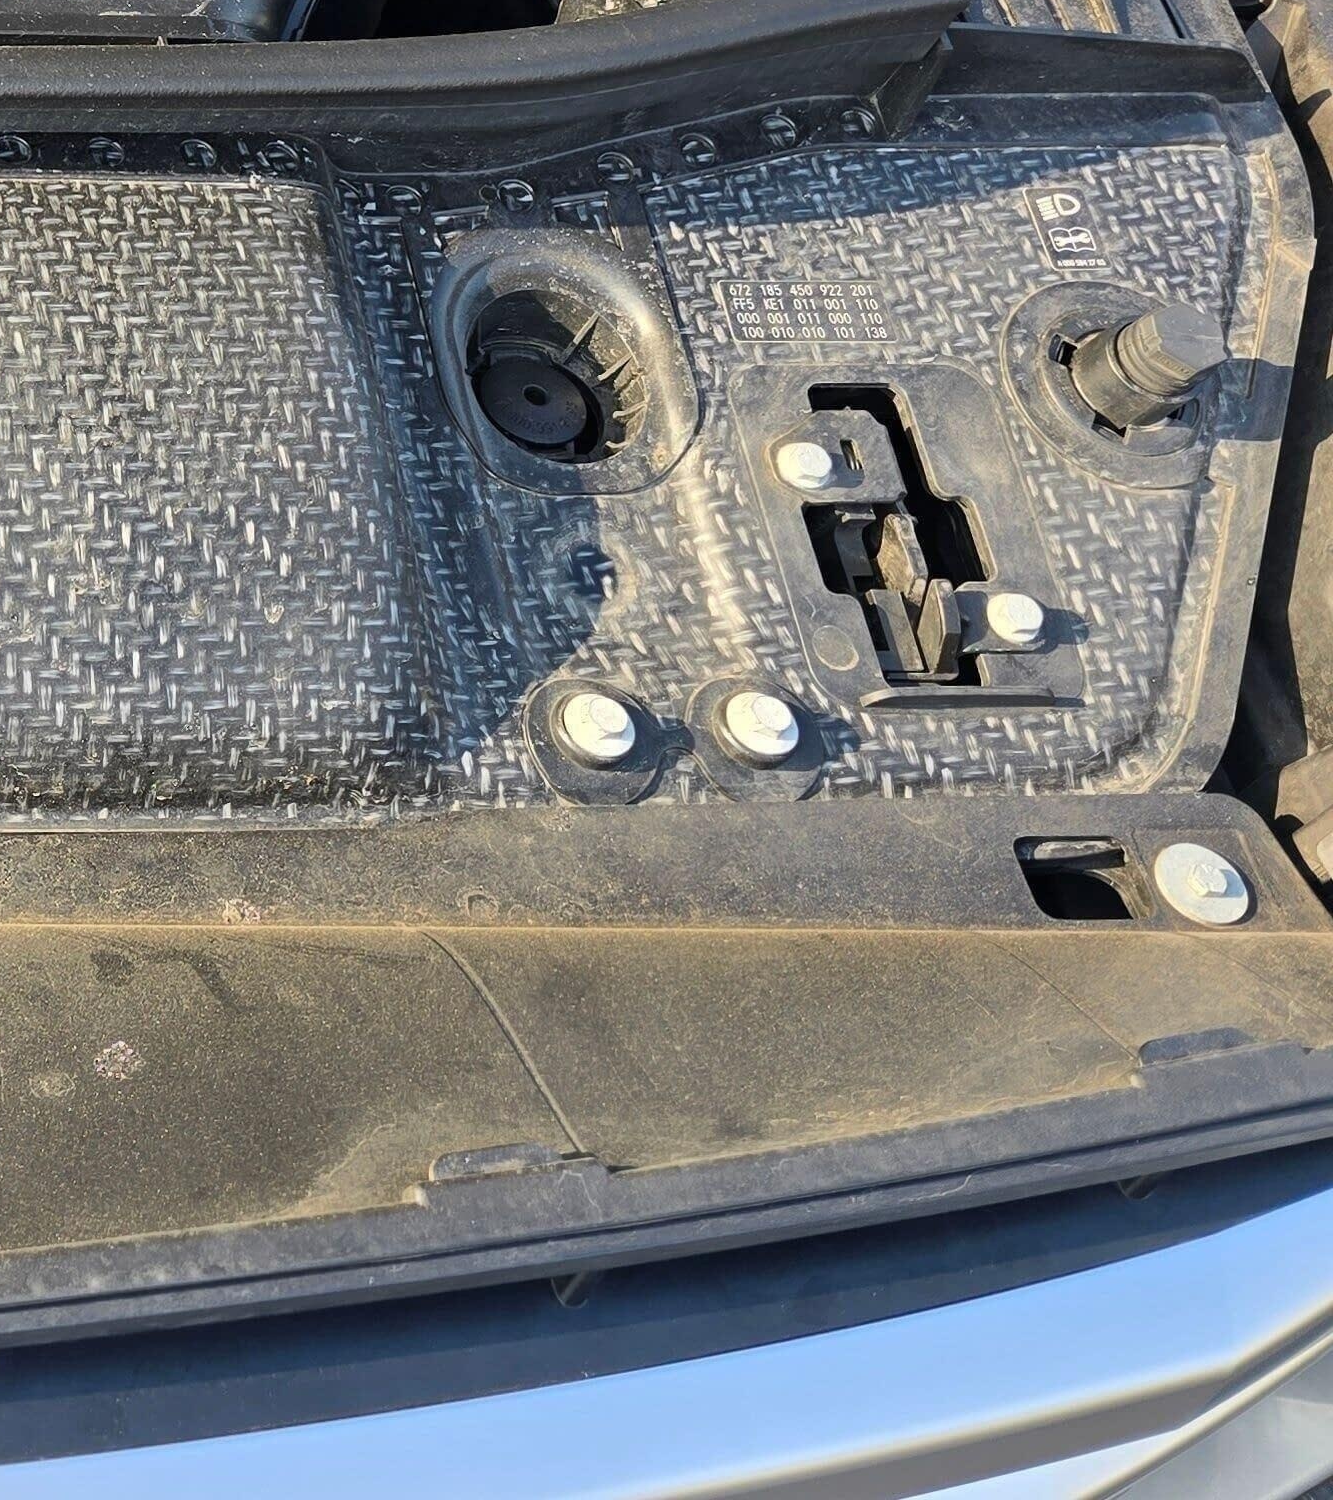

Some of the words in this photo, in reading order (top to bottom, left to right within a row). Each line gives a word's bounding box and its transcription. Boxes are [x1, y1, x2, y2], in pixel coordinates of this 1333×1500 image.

[729, 284, 752, 297] 672
[760, 284, 783, 297] 185
[789, 284, 813, 297] 450
[819, 284, 844, 297] 922
[849, 284, 873, 297] 201
[733, 298, 755, 311] FF5
[764, 298, 785, 311] KE1
[793, 298, 816, 311] 011
[824, 298, 847, 311] 001
[856, 298, 879, 311] 110
[736, 312, 760, 325] 000
[767, 312, 790, 325] 001
[797, 312, 821, 325] 011
[828, 312, 852, 325] 000
[860, 312, 883, 325] 110
[741, 326, 765, 339] 100
[771, 326, 795, 339] 010
[801, 326, 826, 339] 010
[833, 326, 856, 339] 101
[864, 326, 888, 339] 138
